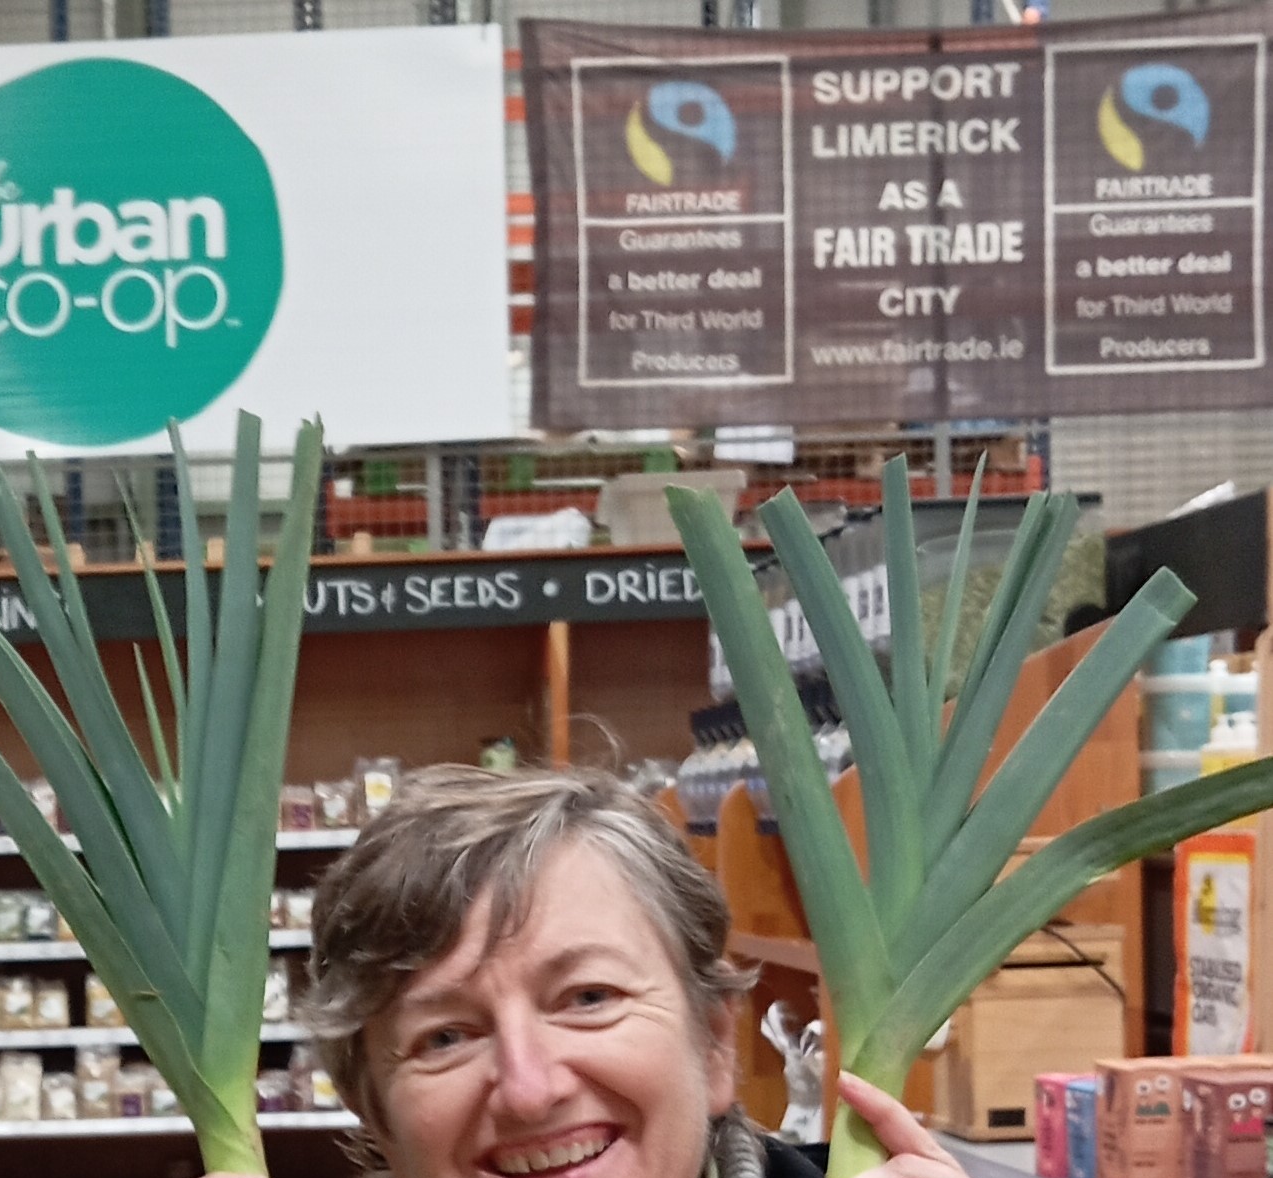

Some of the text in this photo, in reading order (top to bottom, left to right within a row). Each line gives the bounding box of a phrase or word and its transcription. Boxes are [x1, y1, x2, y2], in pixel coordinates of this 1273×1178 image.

[812, 62, 1021, 104] SUPPORT
[811, 117, 1021, 158] LIMERICK
[879, 178, 963, 211] AS A
[1095, 173, 1214, 199] FAIRTRADE
[627, 190, 742, 213] FAIRTRADE
[1089, 213, 1215, 237] Guarantees
[619, 229, 743, 251] Guarantees
[813, 220, 1025, 270] FAIR TRADE
[1076, 250, 1233, 279] a better deal
[607, 266, 763, 291] a better deal
[878, 284, 961, 318] CITY
[1076, 292, 1234, 319] for Third World
[609, 308, 764, 331] for Third World
[631, 350, 741, 372] Producers
[811, 335, 1025, 367] www.fairtrade.ie
[1099, 336, 1212, 359] Producers
[299, 580, 376, 615] UTS
[404, 571, 522, 615] SEEDS
